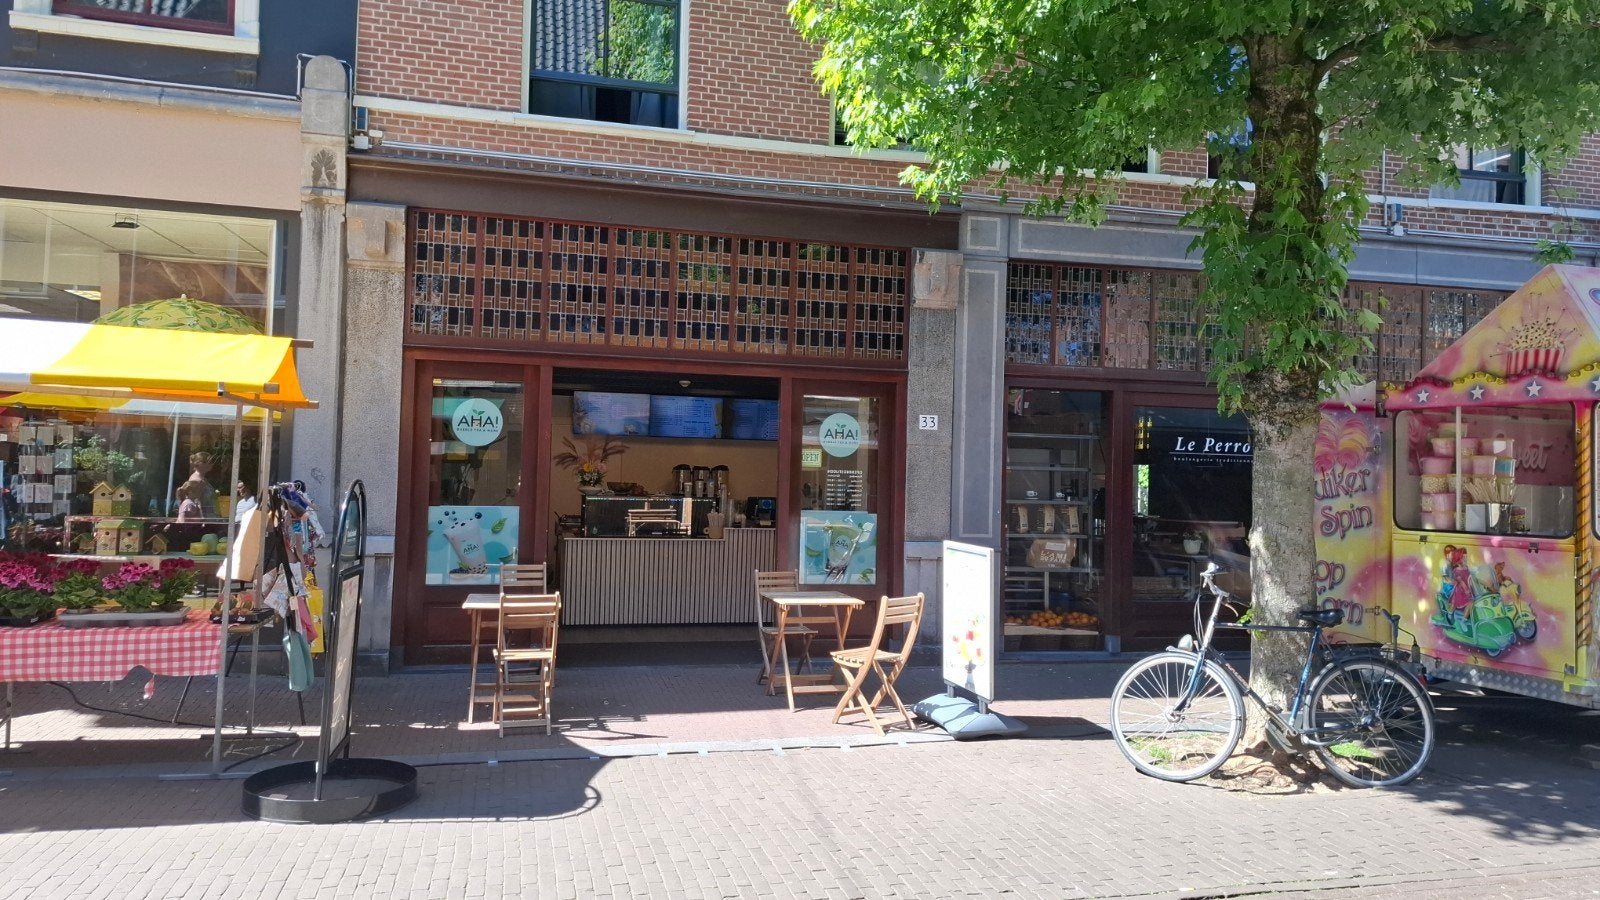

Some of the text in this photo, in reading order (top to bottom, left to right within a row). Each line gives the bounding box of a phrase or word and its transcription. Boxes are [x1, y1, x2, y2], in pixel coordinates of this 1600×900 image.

[457, 415, 499, 428] AHA!
[921, 416, 936, 428] 33
[824, 428, 859, 440] AHA!
[1175, 436, 1251, 454] Le Perro
[1320, 503, 1372, 539] Spin
[1317, 590, 1363, 626] orn
